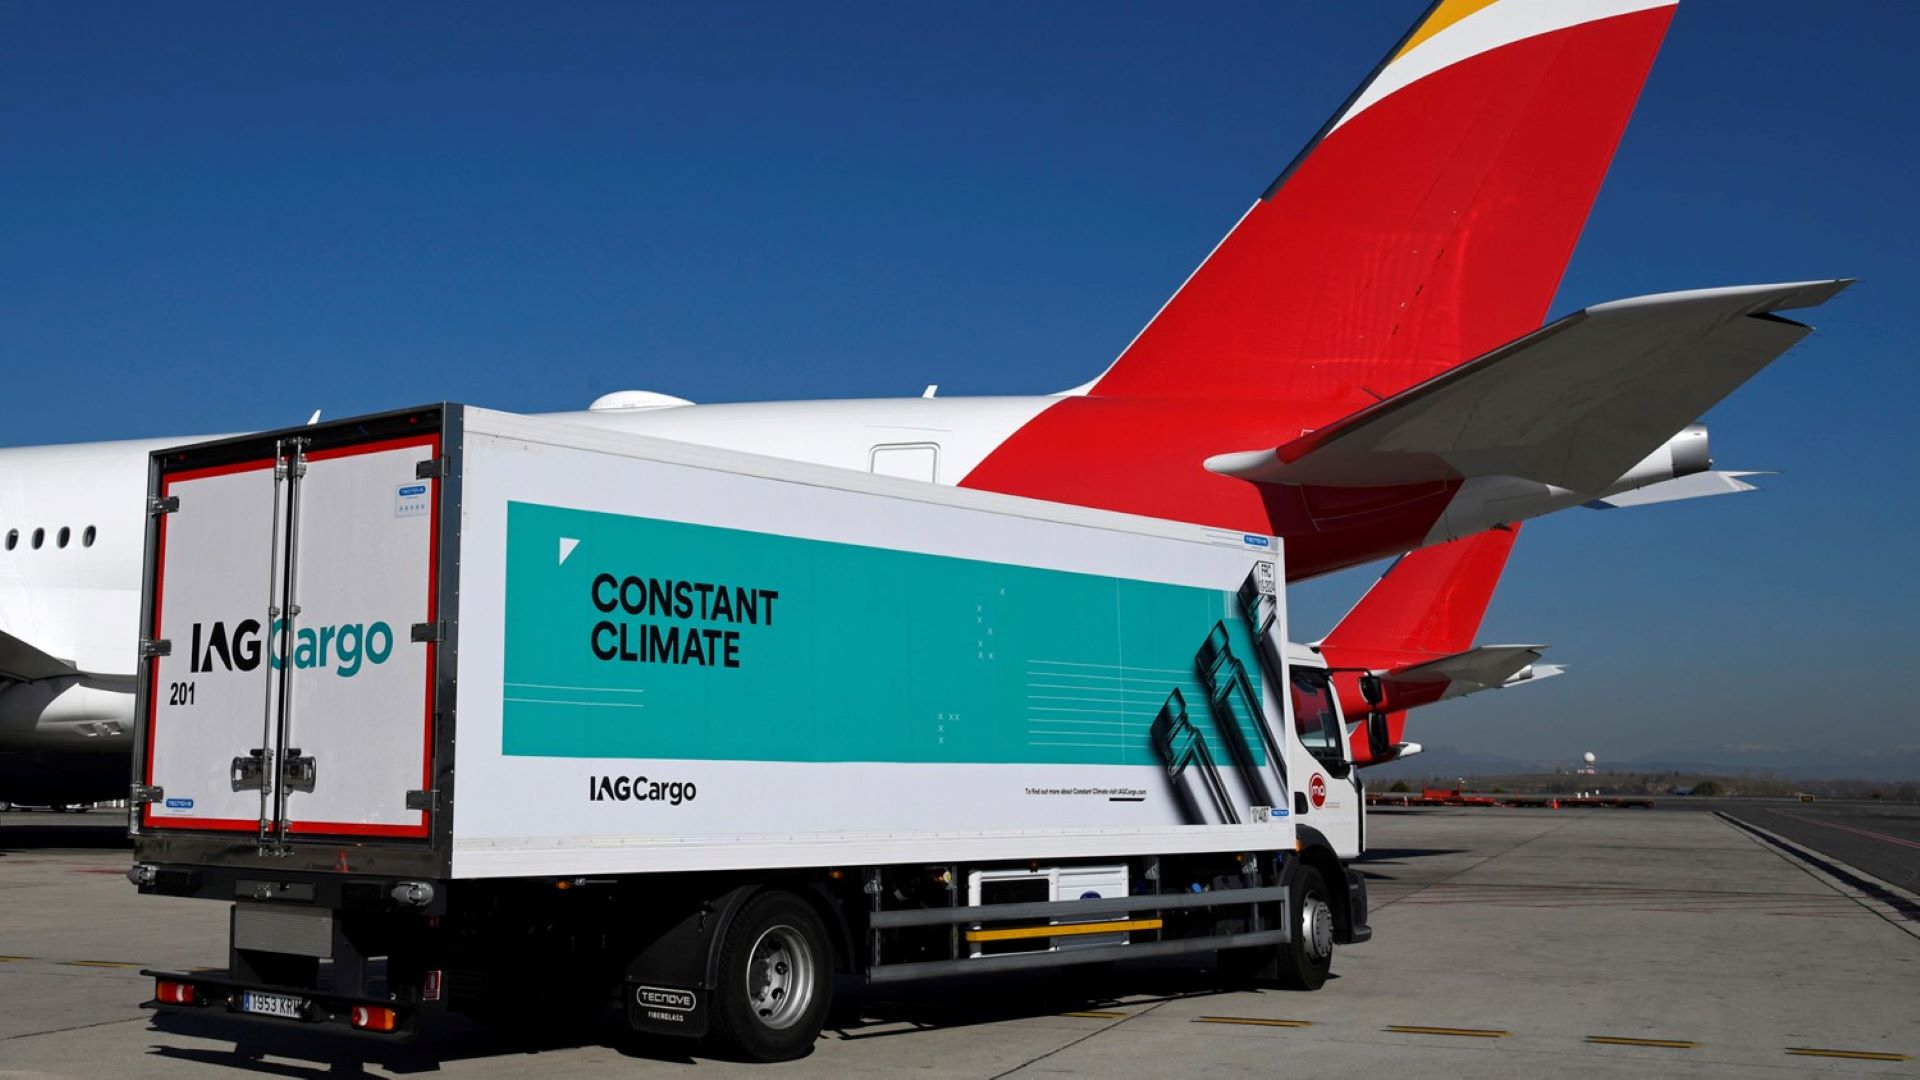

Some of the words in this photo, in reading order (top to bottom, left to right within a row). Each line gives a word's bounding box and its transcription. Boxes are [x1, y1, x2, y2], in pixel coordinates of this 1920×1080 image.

[591, 573, 779, 626] CONSTANT
[591, 620, 741, 669] CLIMATE
[169, 682, 195, 706] 201
[1073, 787, 1092, 795] Constant
[1092, 787, 1109, 795] Climate
[641, 992, 691, 1006] TECNOVE
